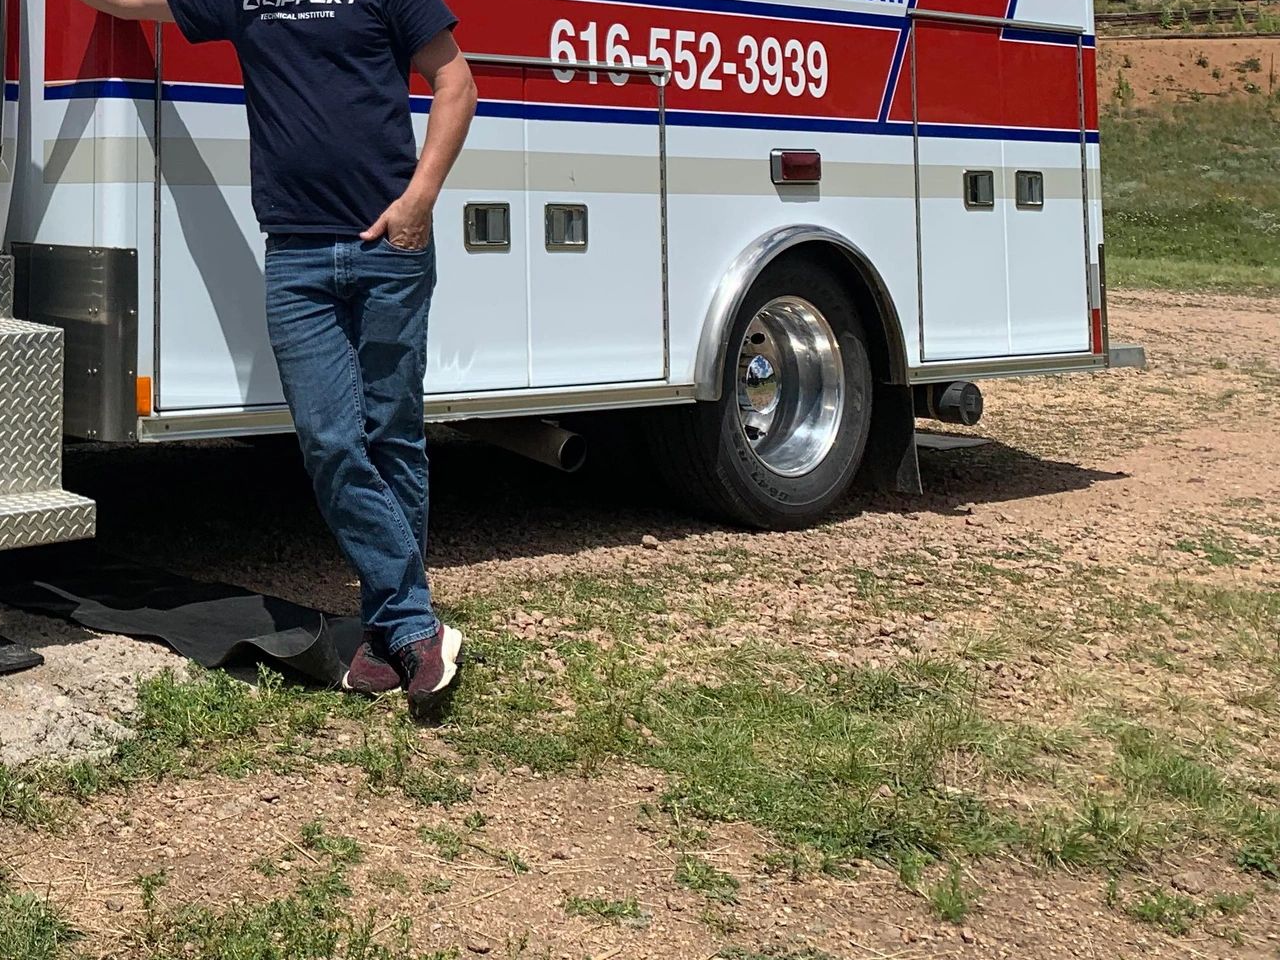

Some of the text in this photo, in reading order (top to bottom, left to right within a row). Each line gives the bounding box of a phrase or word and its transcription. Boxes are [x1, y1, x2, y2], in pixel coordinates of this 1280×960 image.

[260, 10, 335, 20] TECHNICAL INSTITUTE
[549, 18, 829, 99] 616-552-3939
